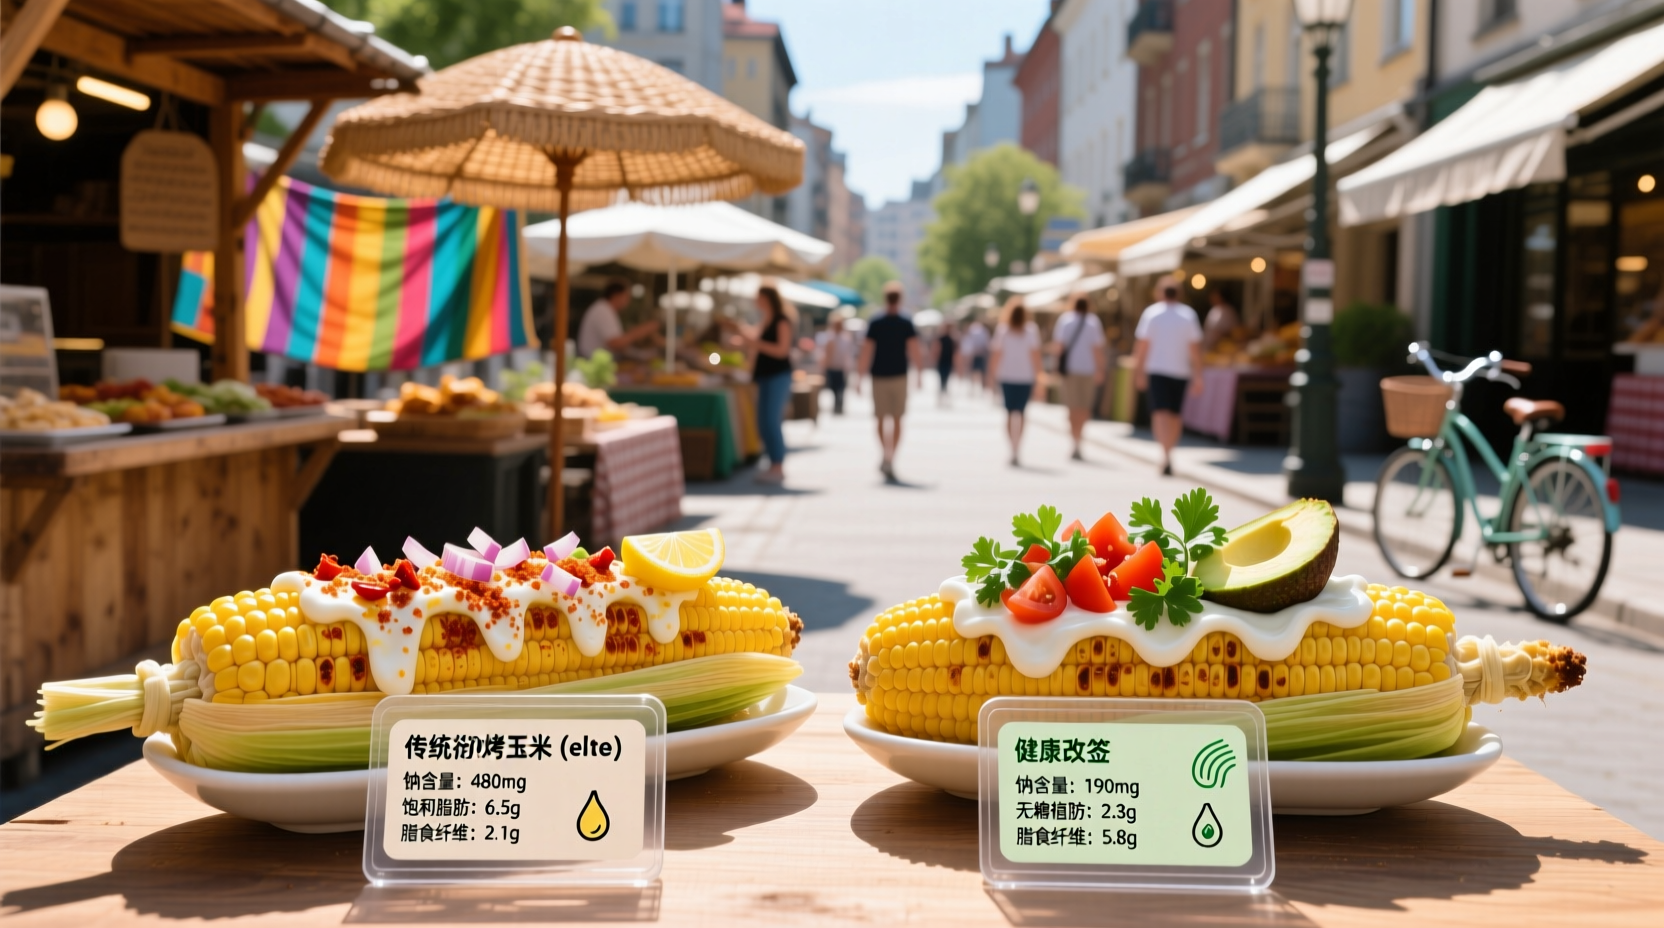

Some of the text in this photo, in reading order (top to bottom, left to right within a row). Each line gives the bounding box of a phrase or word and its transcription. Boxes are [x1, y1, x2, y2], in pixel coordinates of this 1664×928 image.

[1014, 736, 1111, 764] 健康改签
[470, 773, 527, 794] 480mg
[1085, 778, 1140, 799] 190mg
[485, 799, 521, 820] 6.5g
[1101, 803, 1137, 824] 2.3g
[484, 824, 520, 845] 2.1g
[1102, 829, 1137, 850] 5.8g
